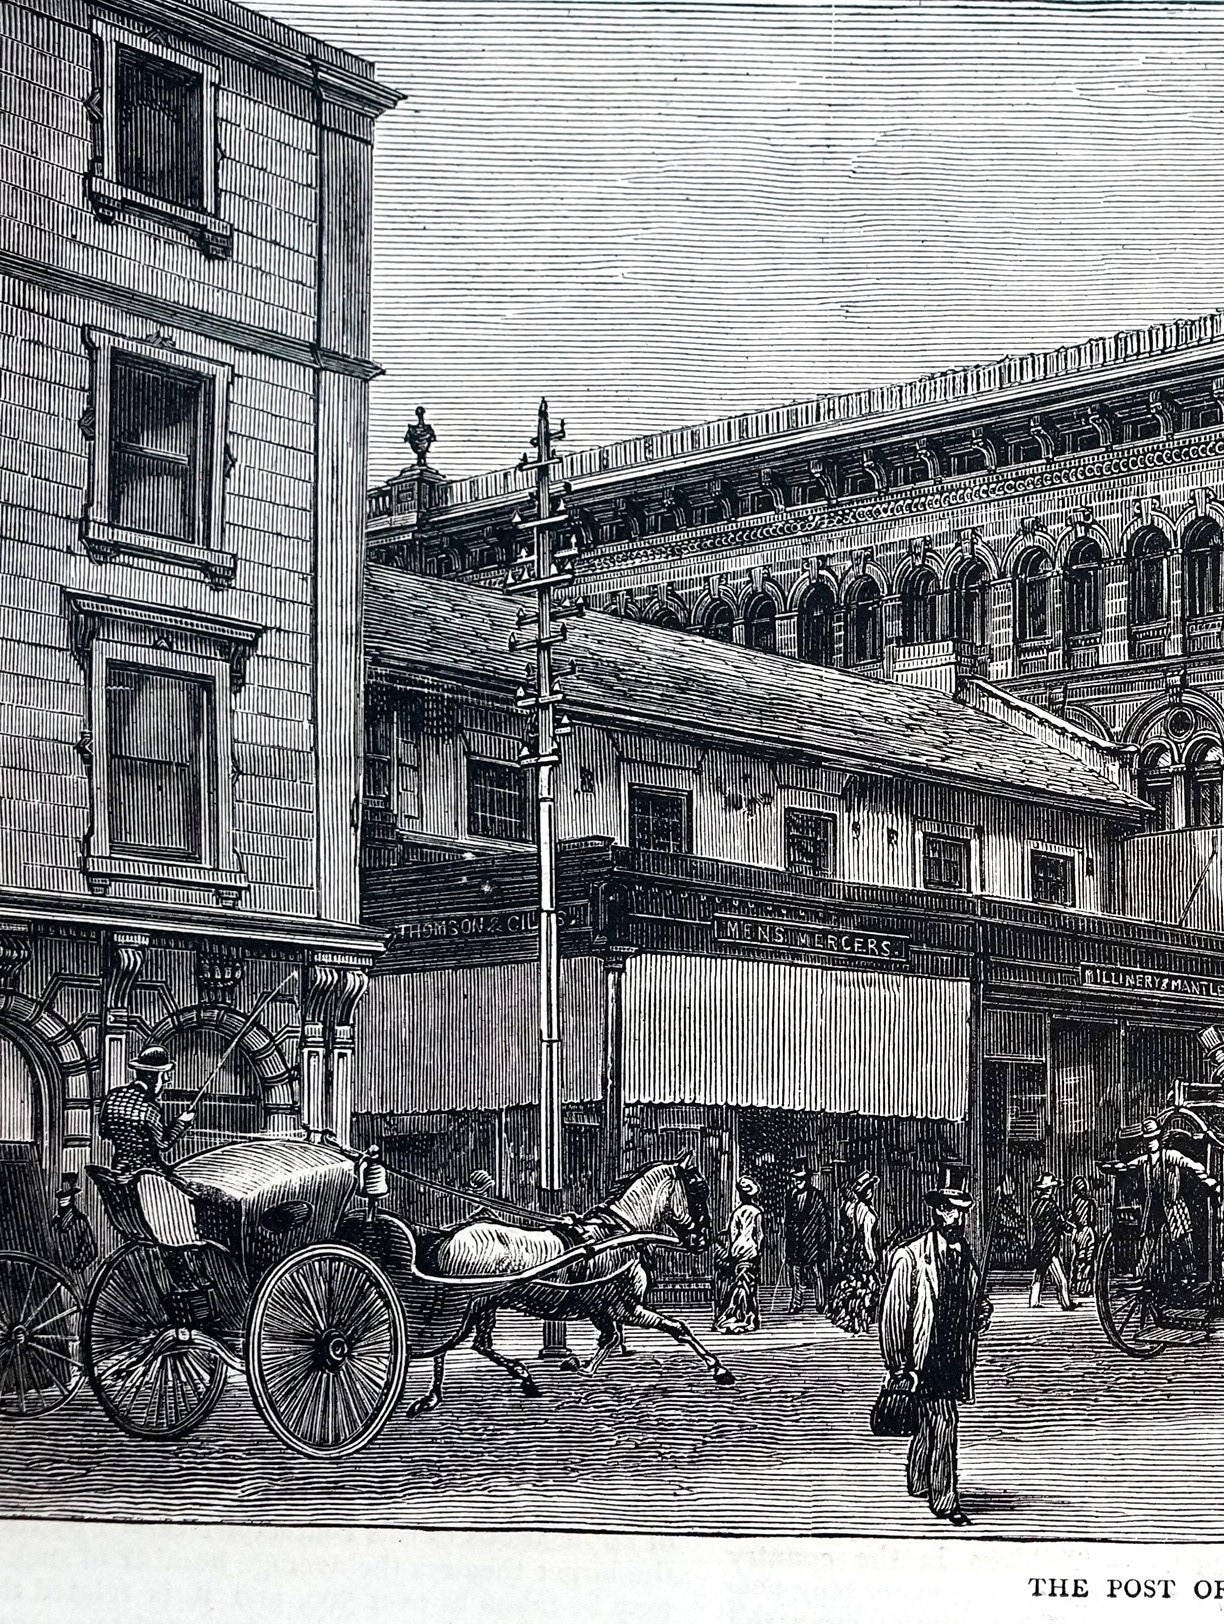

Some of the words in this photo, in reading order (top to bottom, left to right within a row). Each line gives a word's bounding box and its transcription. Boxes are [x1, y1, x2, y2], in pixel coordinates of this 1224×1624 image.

[727, 921, 786, 943] MENS
[1028, 1578, 1089, 1597] THE
[1106, 1579, 1176, 1599] POST
